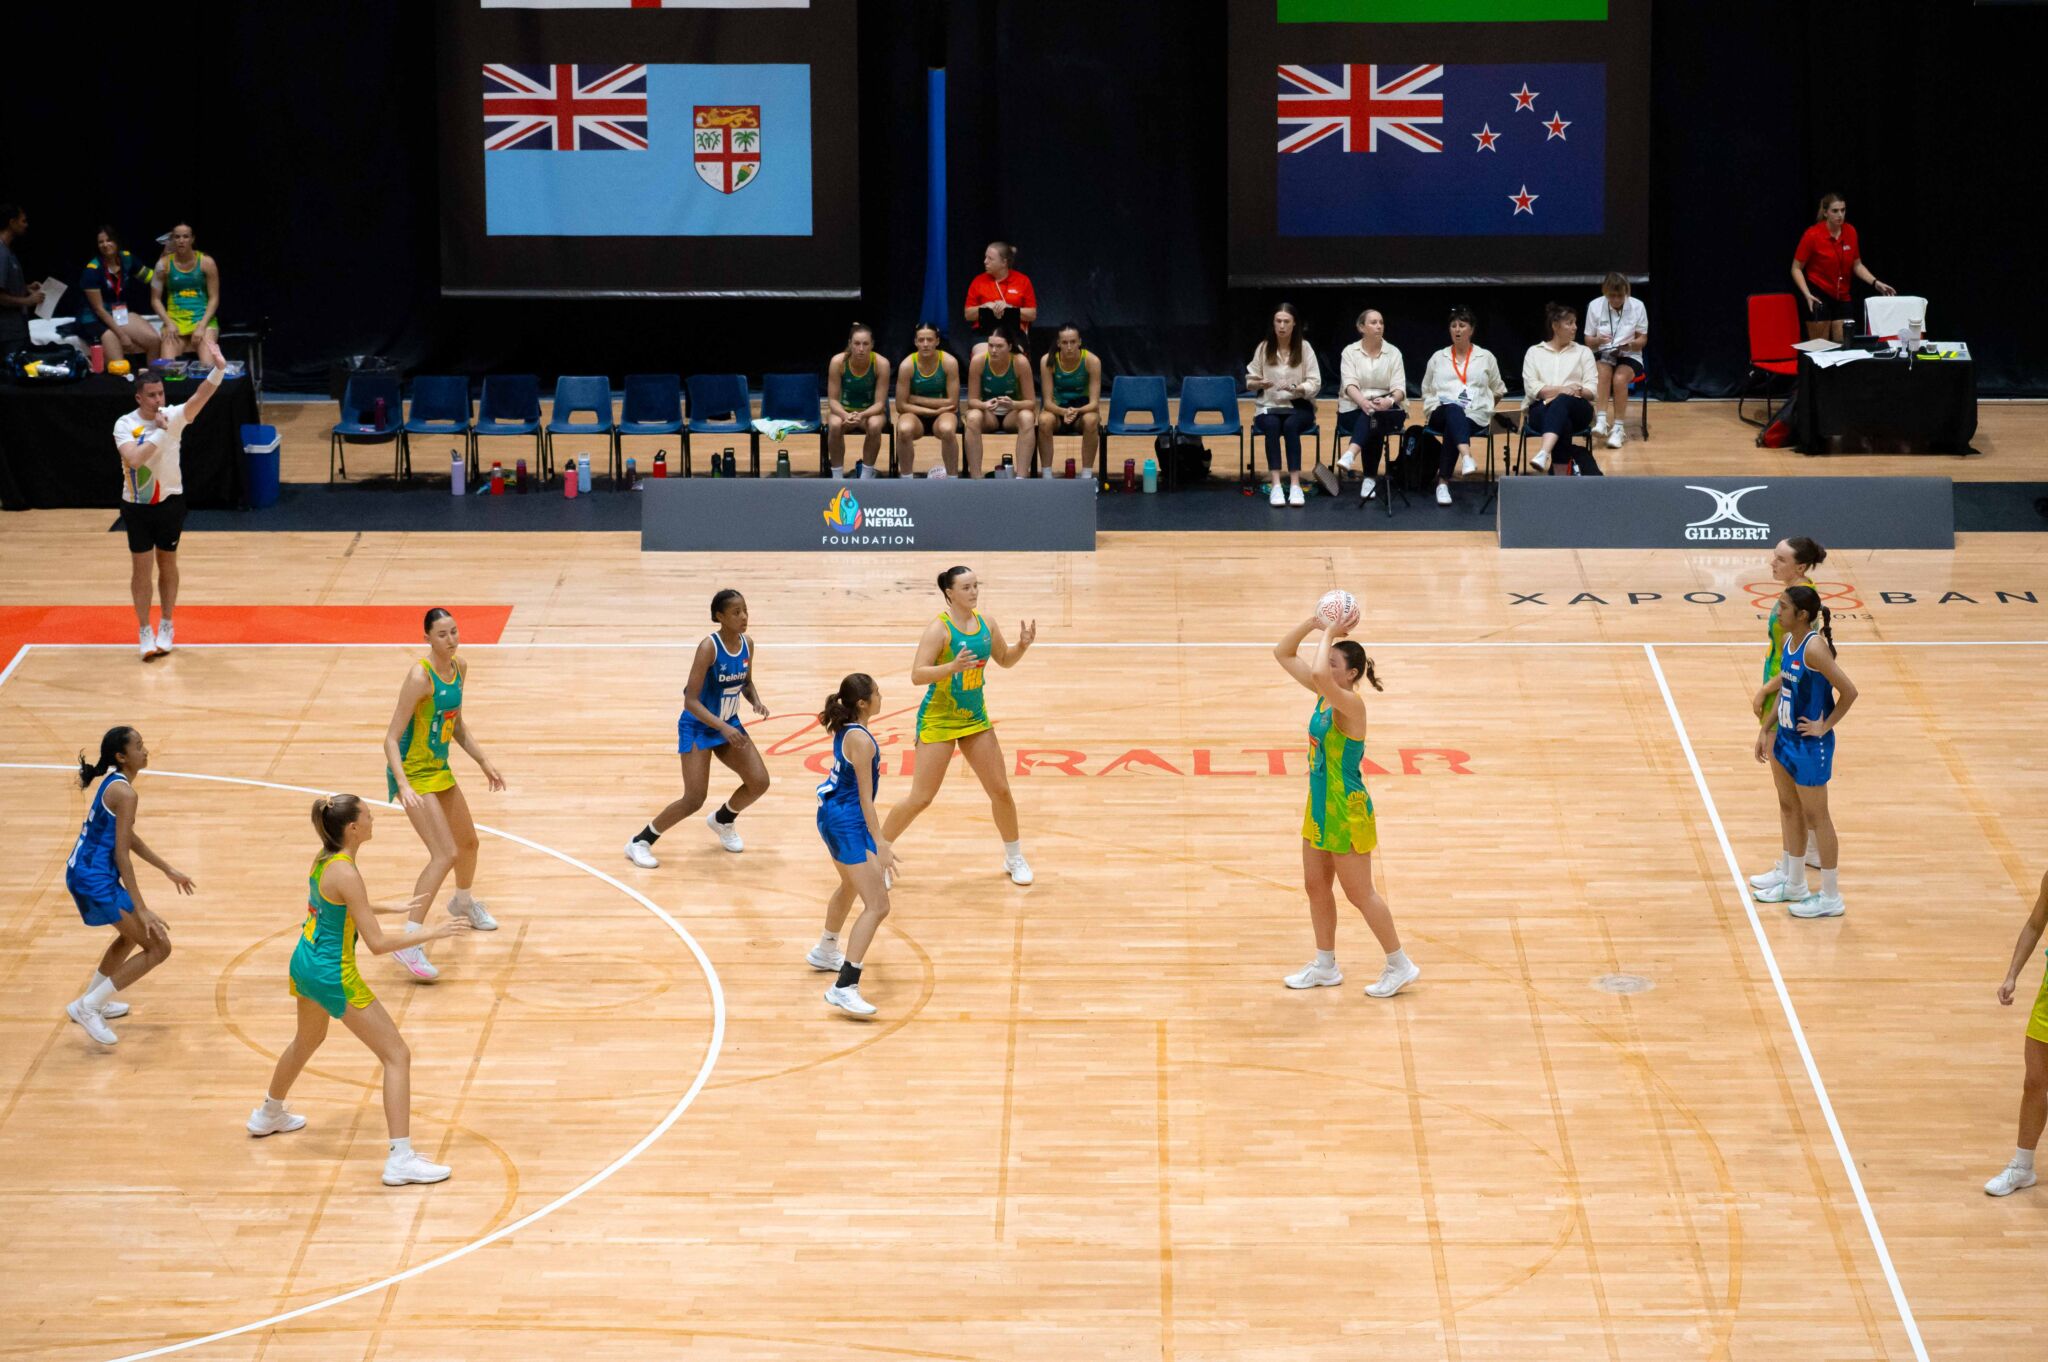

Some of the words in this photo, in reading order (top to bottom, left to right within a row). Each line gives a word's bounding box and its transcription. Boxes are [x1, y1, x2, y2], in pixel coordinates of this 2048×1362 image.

[863, 508, 907, 517] WORLD
[865, 517, 914, 527] NETBALL
[1685, 527, 1770, 540] GILBERT
[822, 535, 915, 545] FOUNDATION
[1507, 591, 1726, 605] XAPO
[718, 671, 747, 683] Deloitt
[804, 748, 1475, 776] GIRALTR
